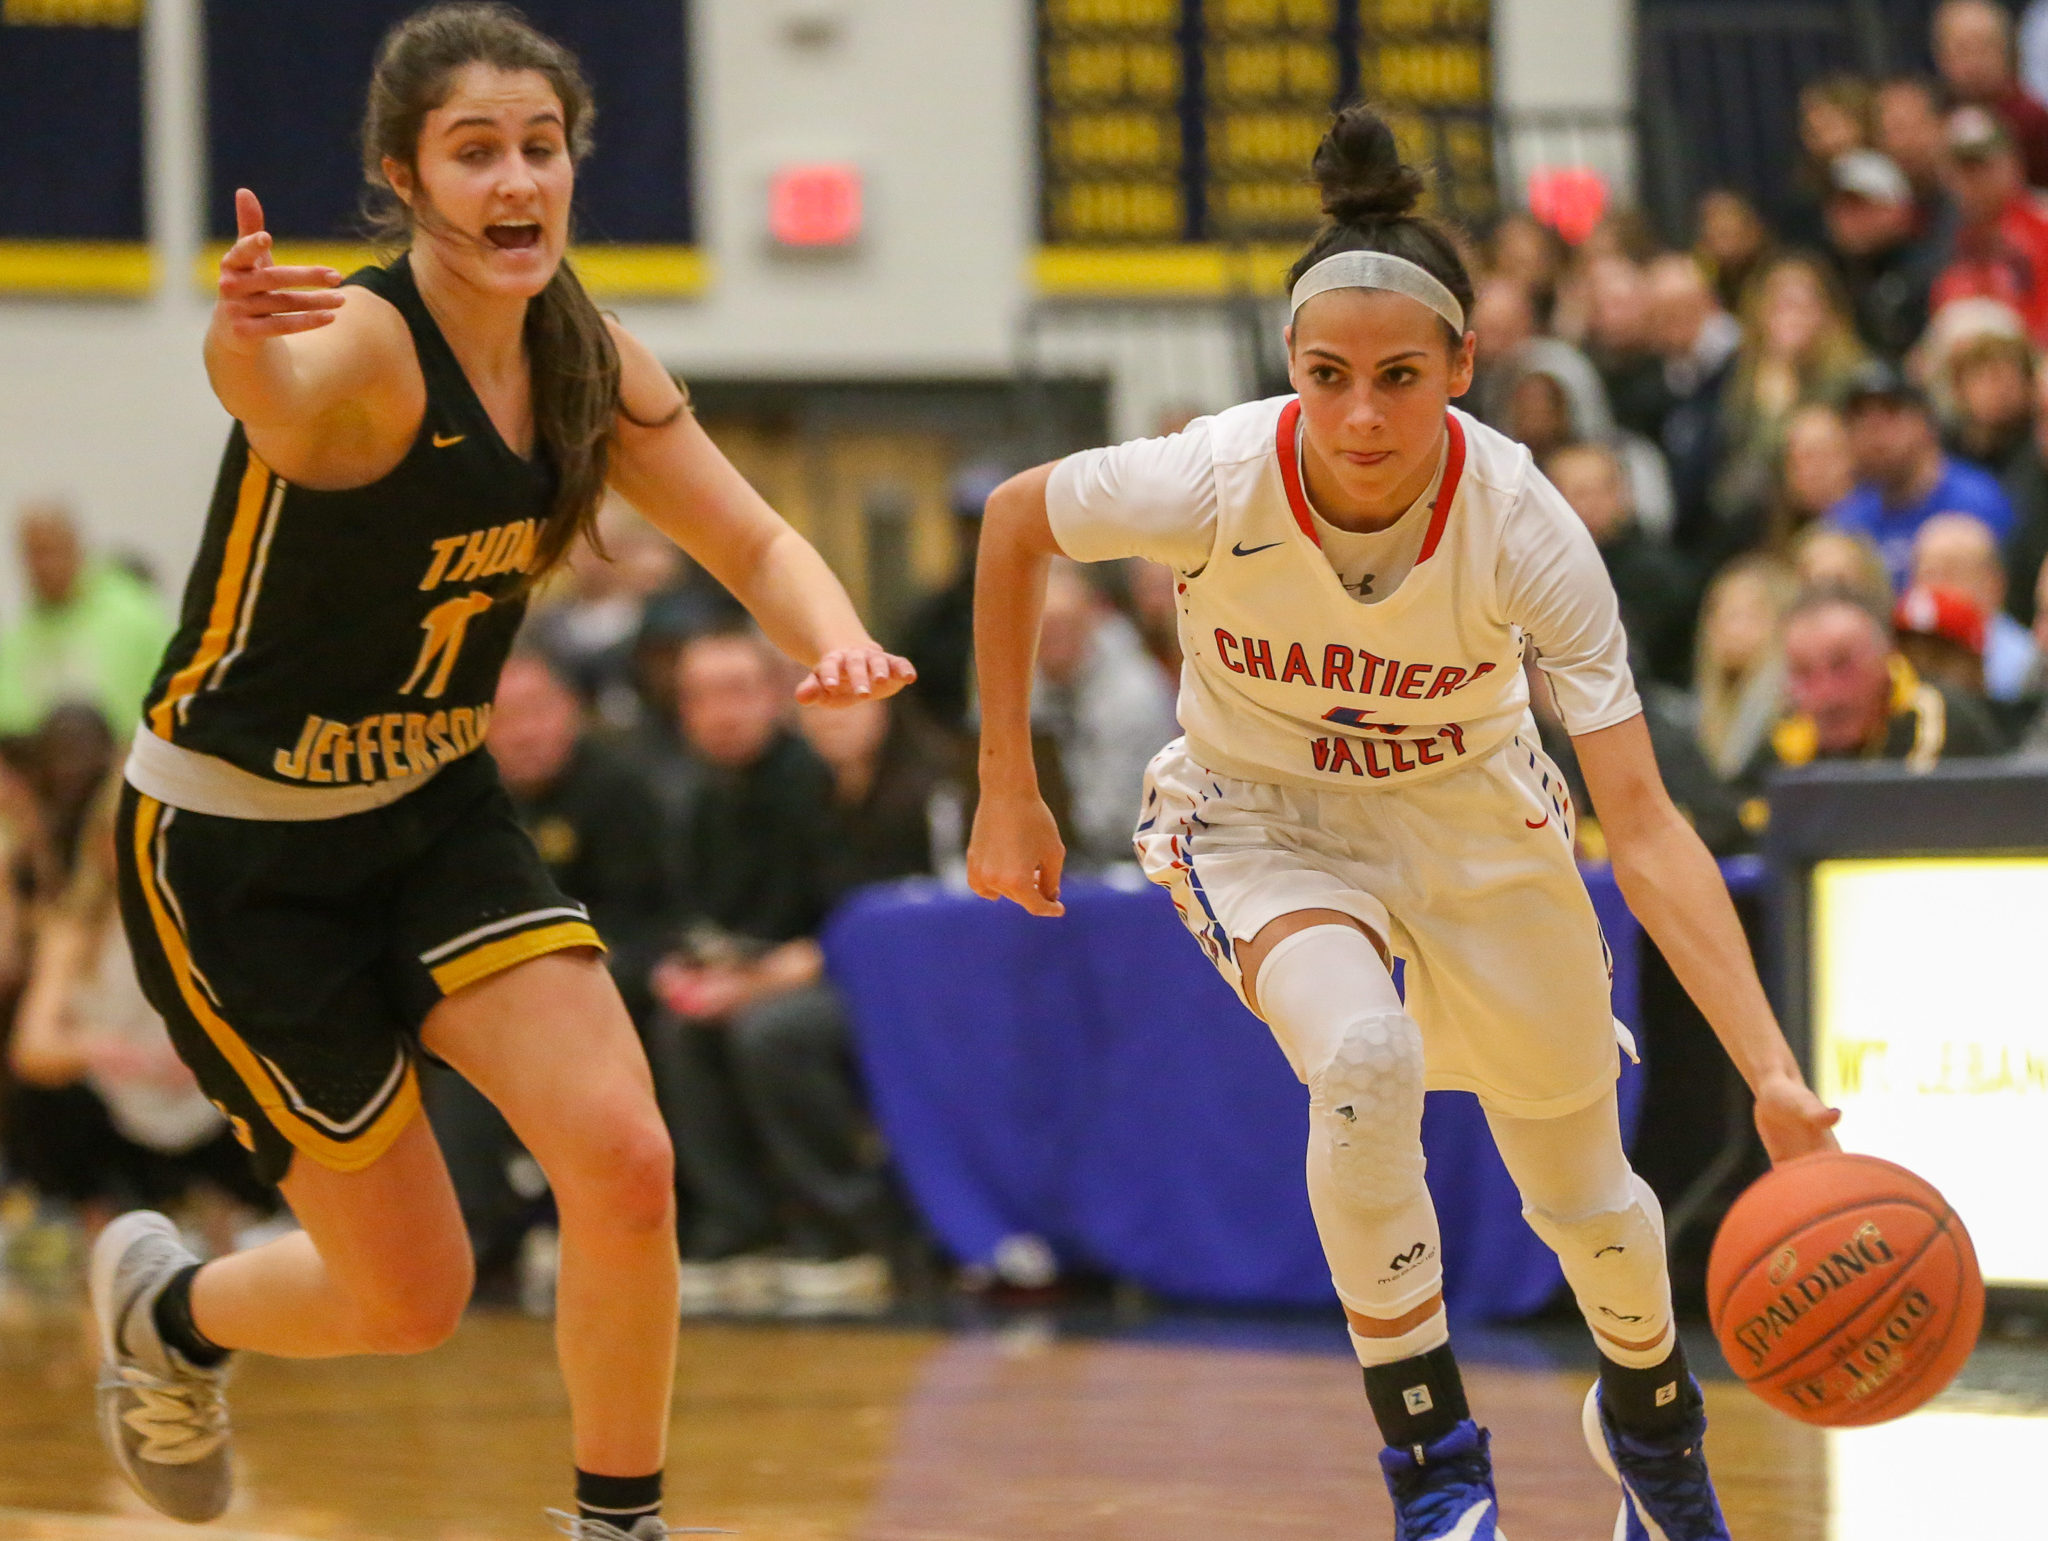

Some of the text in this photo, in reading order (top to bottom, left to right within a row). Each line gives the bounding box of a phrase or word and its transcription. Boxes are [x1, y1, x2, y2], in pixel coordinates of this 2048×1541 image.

[419, 518, 548, 591] THOM
[1311, 723, 1466, 778] VALLEY
[1734, 1221, 1895, 1368] SPALDING
